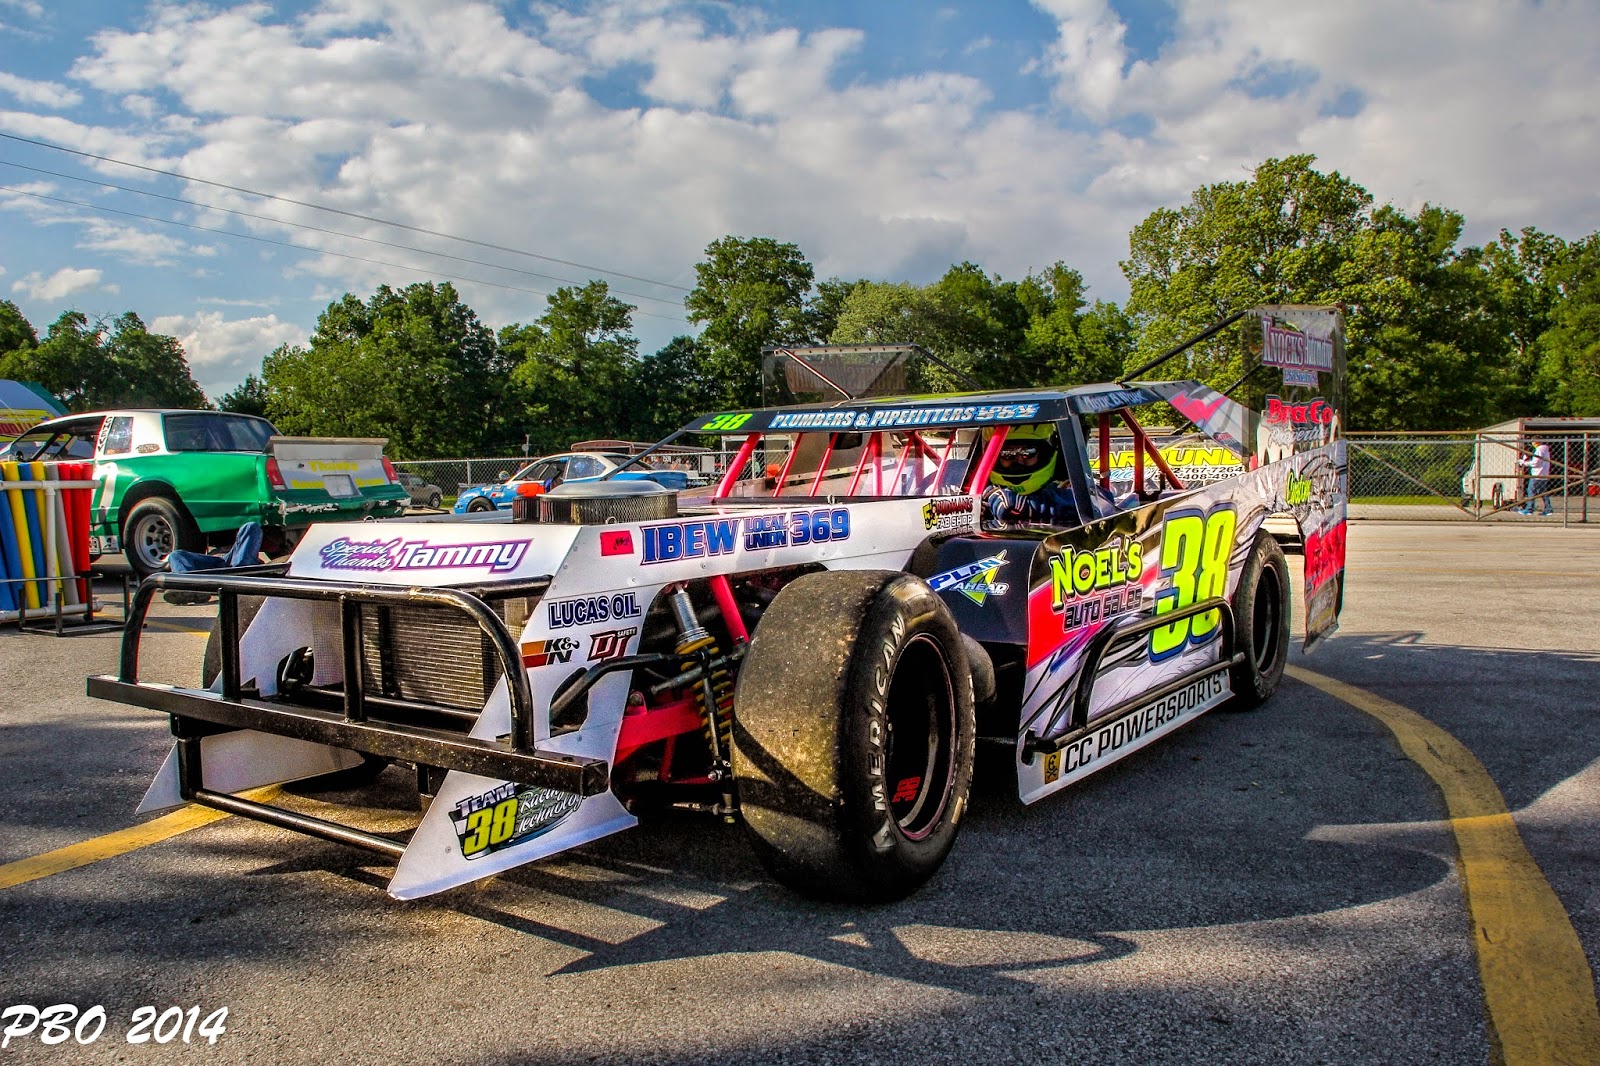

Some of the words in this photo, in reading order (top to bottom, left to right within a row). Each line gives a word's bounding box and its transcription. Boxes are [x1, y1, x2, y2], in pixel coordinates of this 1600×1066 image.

[701, 413, 753, 430] 38
[768, 411, 857, 429] PLUMBERS
[855, 412, 870, 428] &
[871, 406, 976, 427] PIPEFITTERS
[97, 416, 113, 452] CHEVY
[1158, 466, 1244, 474] 2-767-7264
[640, 518, 740, 565] IBEW
[745, 514, 787, 532] LOCAL
[791, 507, 850, 545] 369
[937, 516, 950, 529] FAB
[951, 514, 972, 527] SHOP
[321, 538, 401, 555] Special
[396, 540, 533, 573] Tammy
[745, 531, 787, 550] UNION
[322, 552, 392, 570] Thanks
[929, 559, 1001, 589] PLAN
[953, 582, 1008, 593] AHEAD
[1150, 504, 1237, 663] 38
[548, 596, 610, 629] LUCAS
[612, 592, 641, 619] OIL
[617, 628, 637, 638] SAFETY
[1064, 737, 1093, 774] CC
[1097, 673, 1222, 758] POWERSPORTS
[456, 782, 516, 818] TEAM
[519, 793, 585, 833] Technolog
[520, 788, 565, 814] Racing
[463, 798, 518, 856] 38
